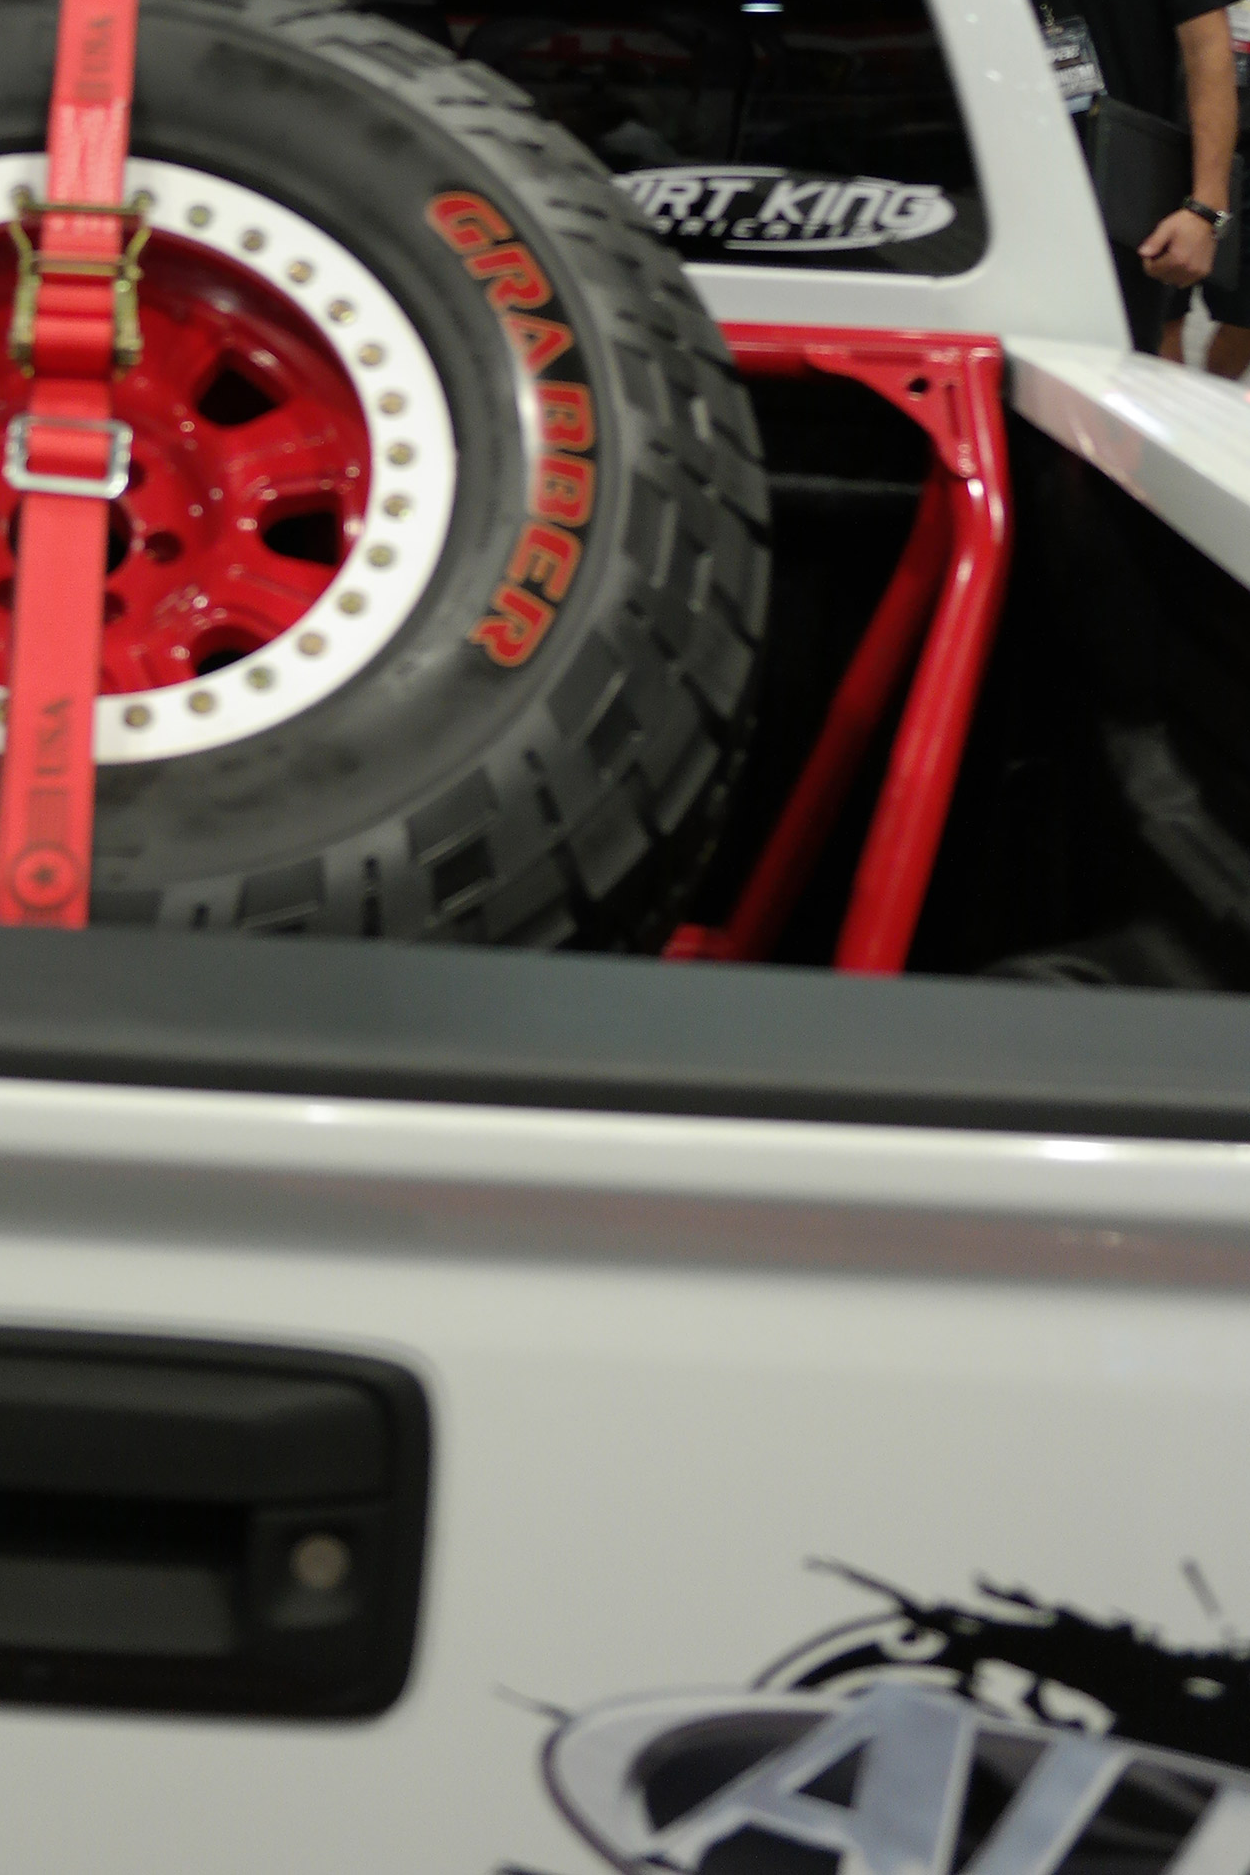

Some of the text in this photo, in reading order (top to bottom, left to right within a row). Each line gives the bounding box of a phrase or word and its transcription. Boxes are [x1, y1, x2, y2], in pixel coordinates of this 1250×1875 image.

[614, 177, 935, 228] IRT KING
[425, 190, 598, 669] GRABBER
